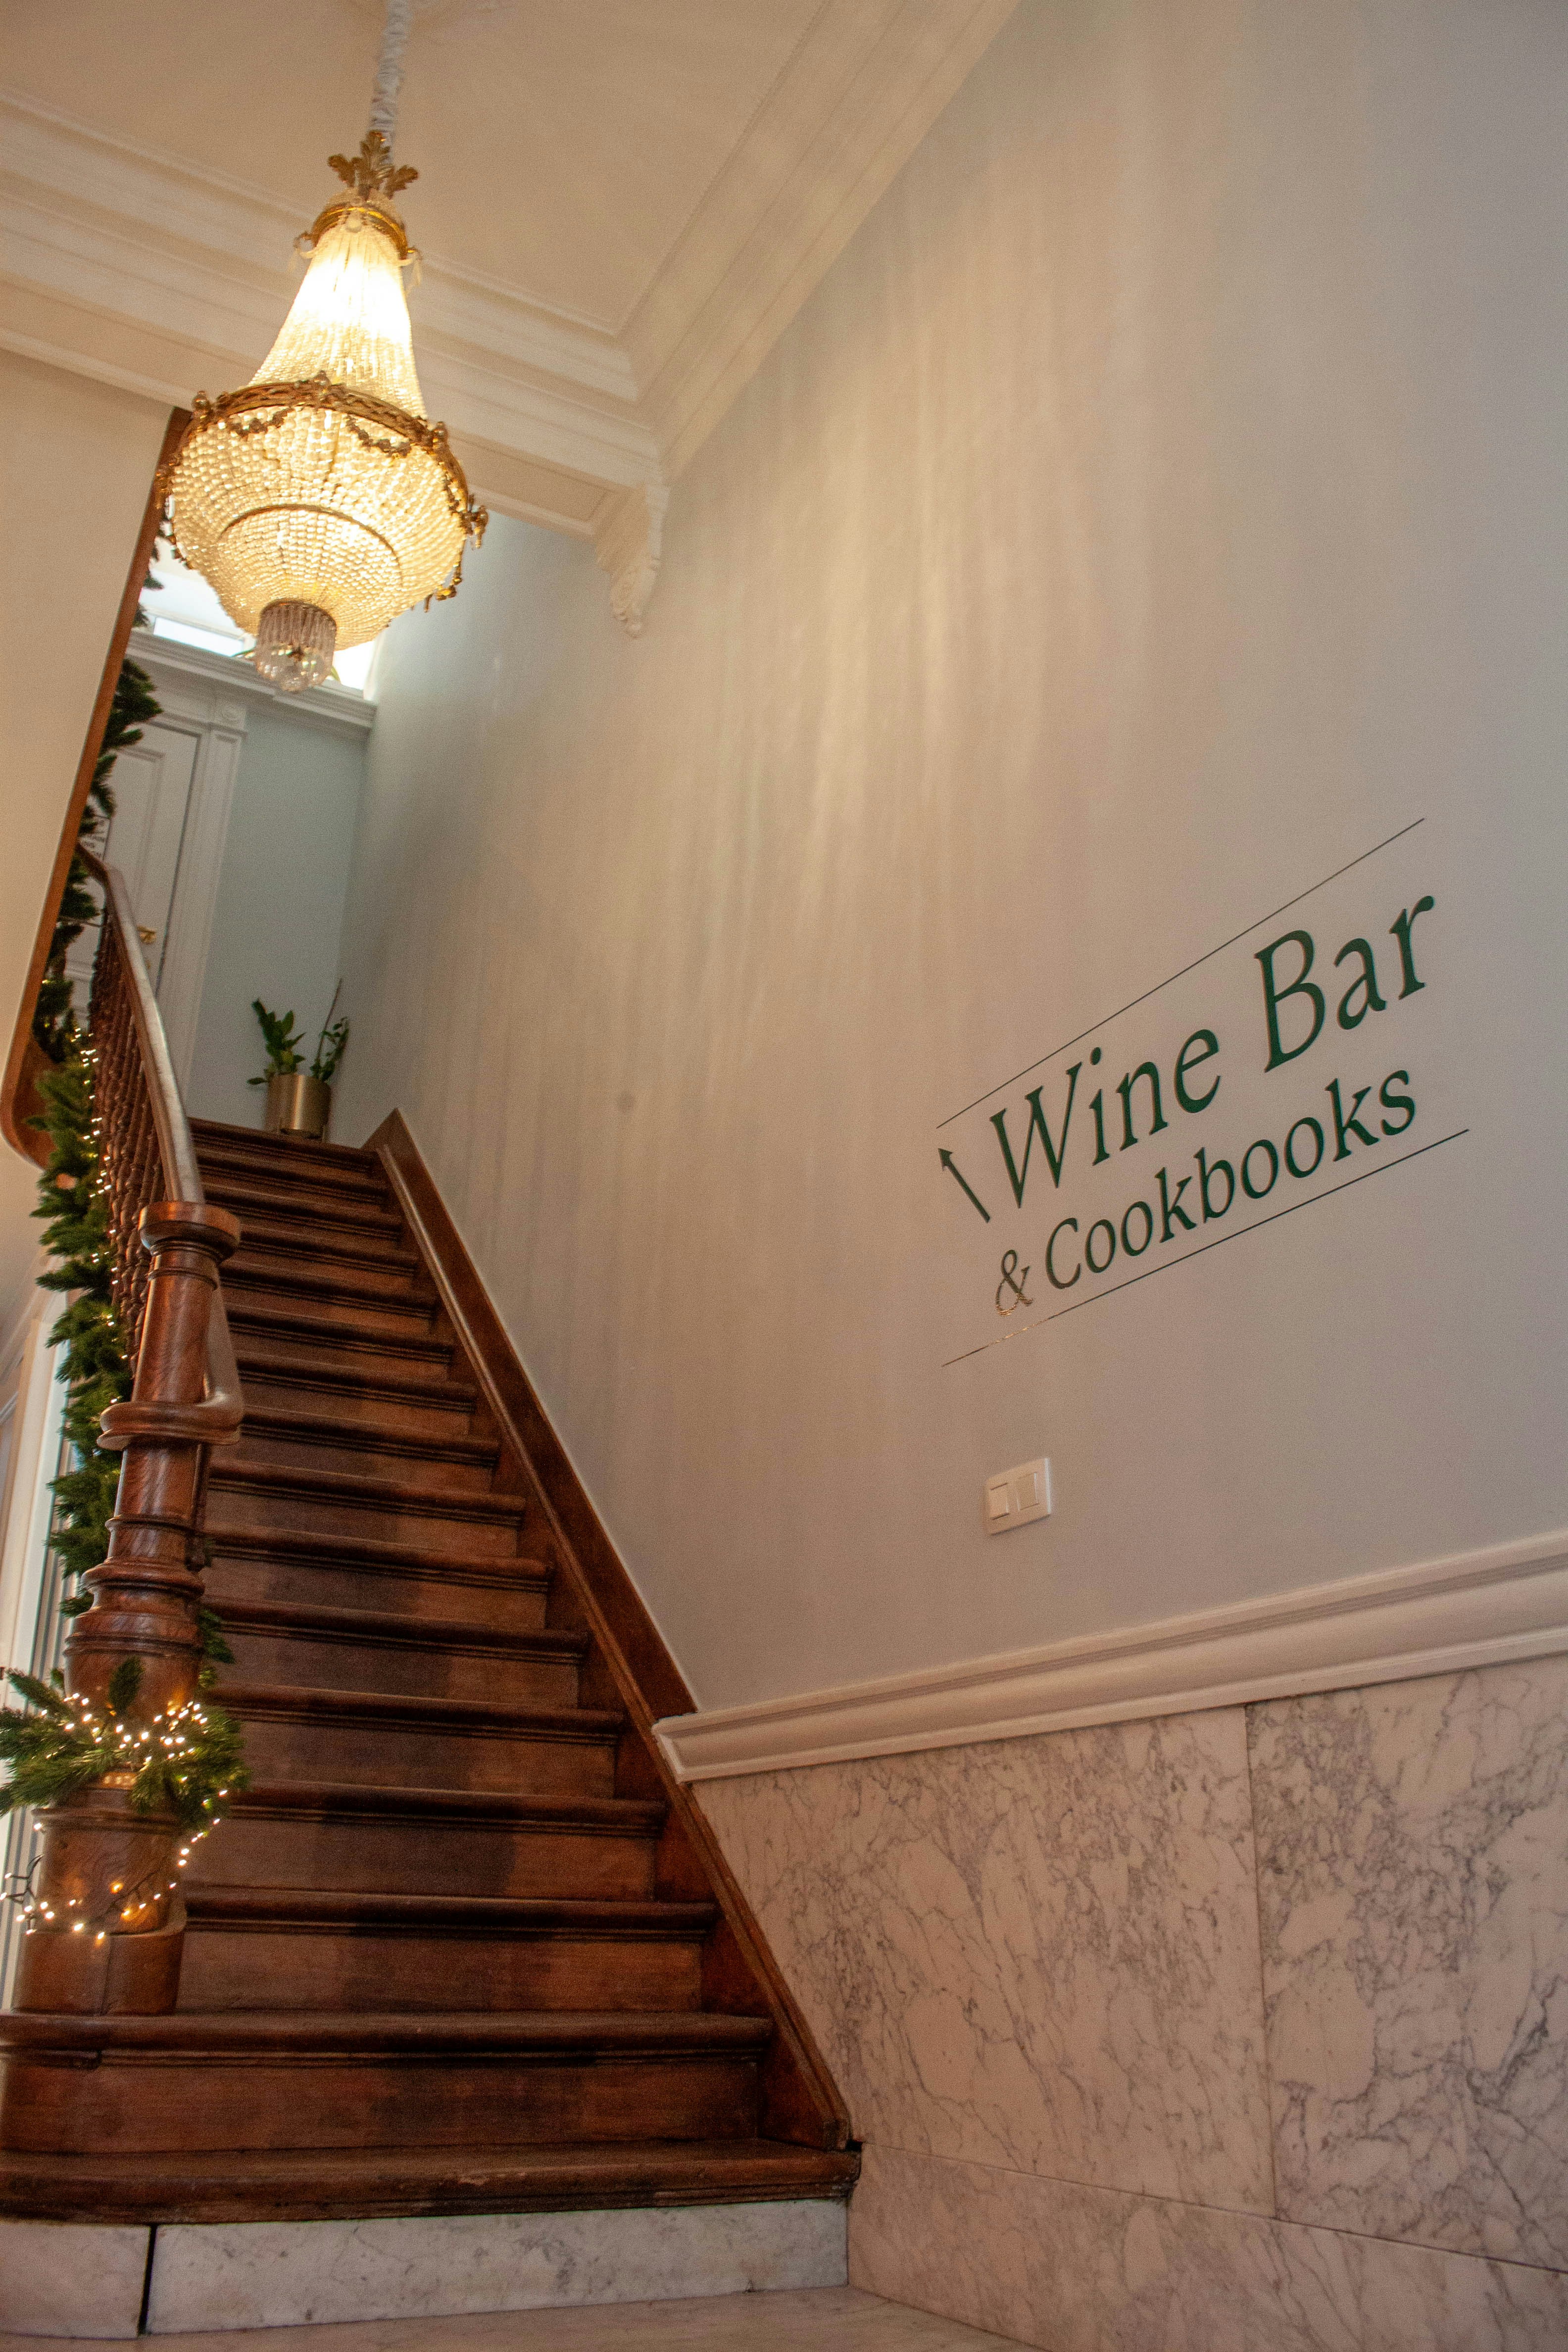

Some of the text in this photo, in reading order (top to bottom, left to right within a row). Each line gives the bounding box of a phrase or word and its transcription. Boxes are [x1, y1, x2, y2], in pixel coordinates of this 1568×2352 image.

[990, 895, 1434, 1208] Wine Bar
[995, 1070, 1416, 1316] & Cookbooks
